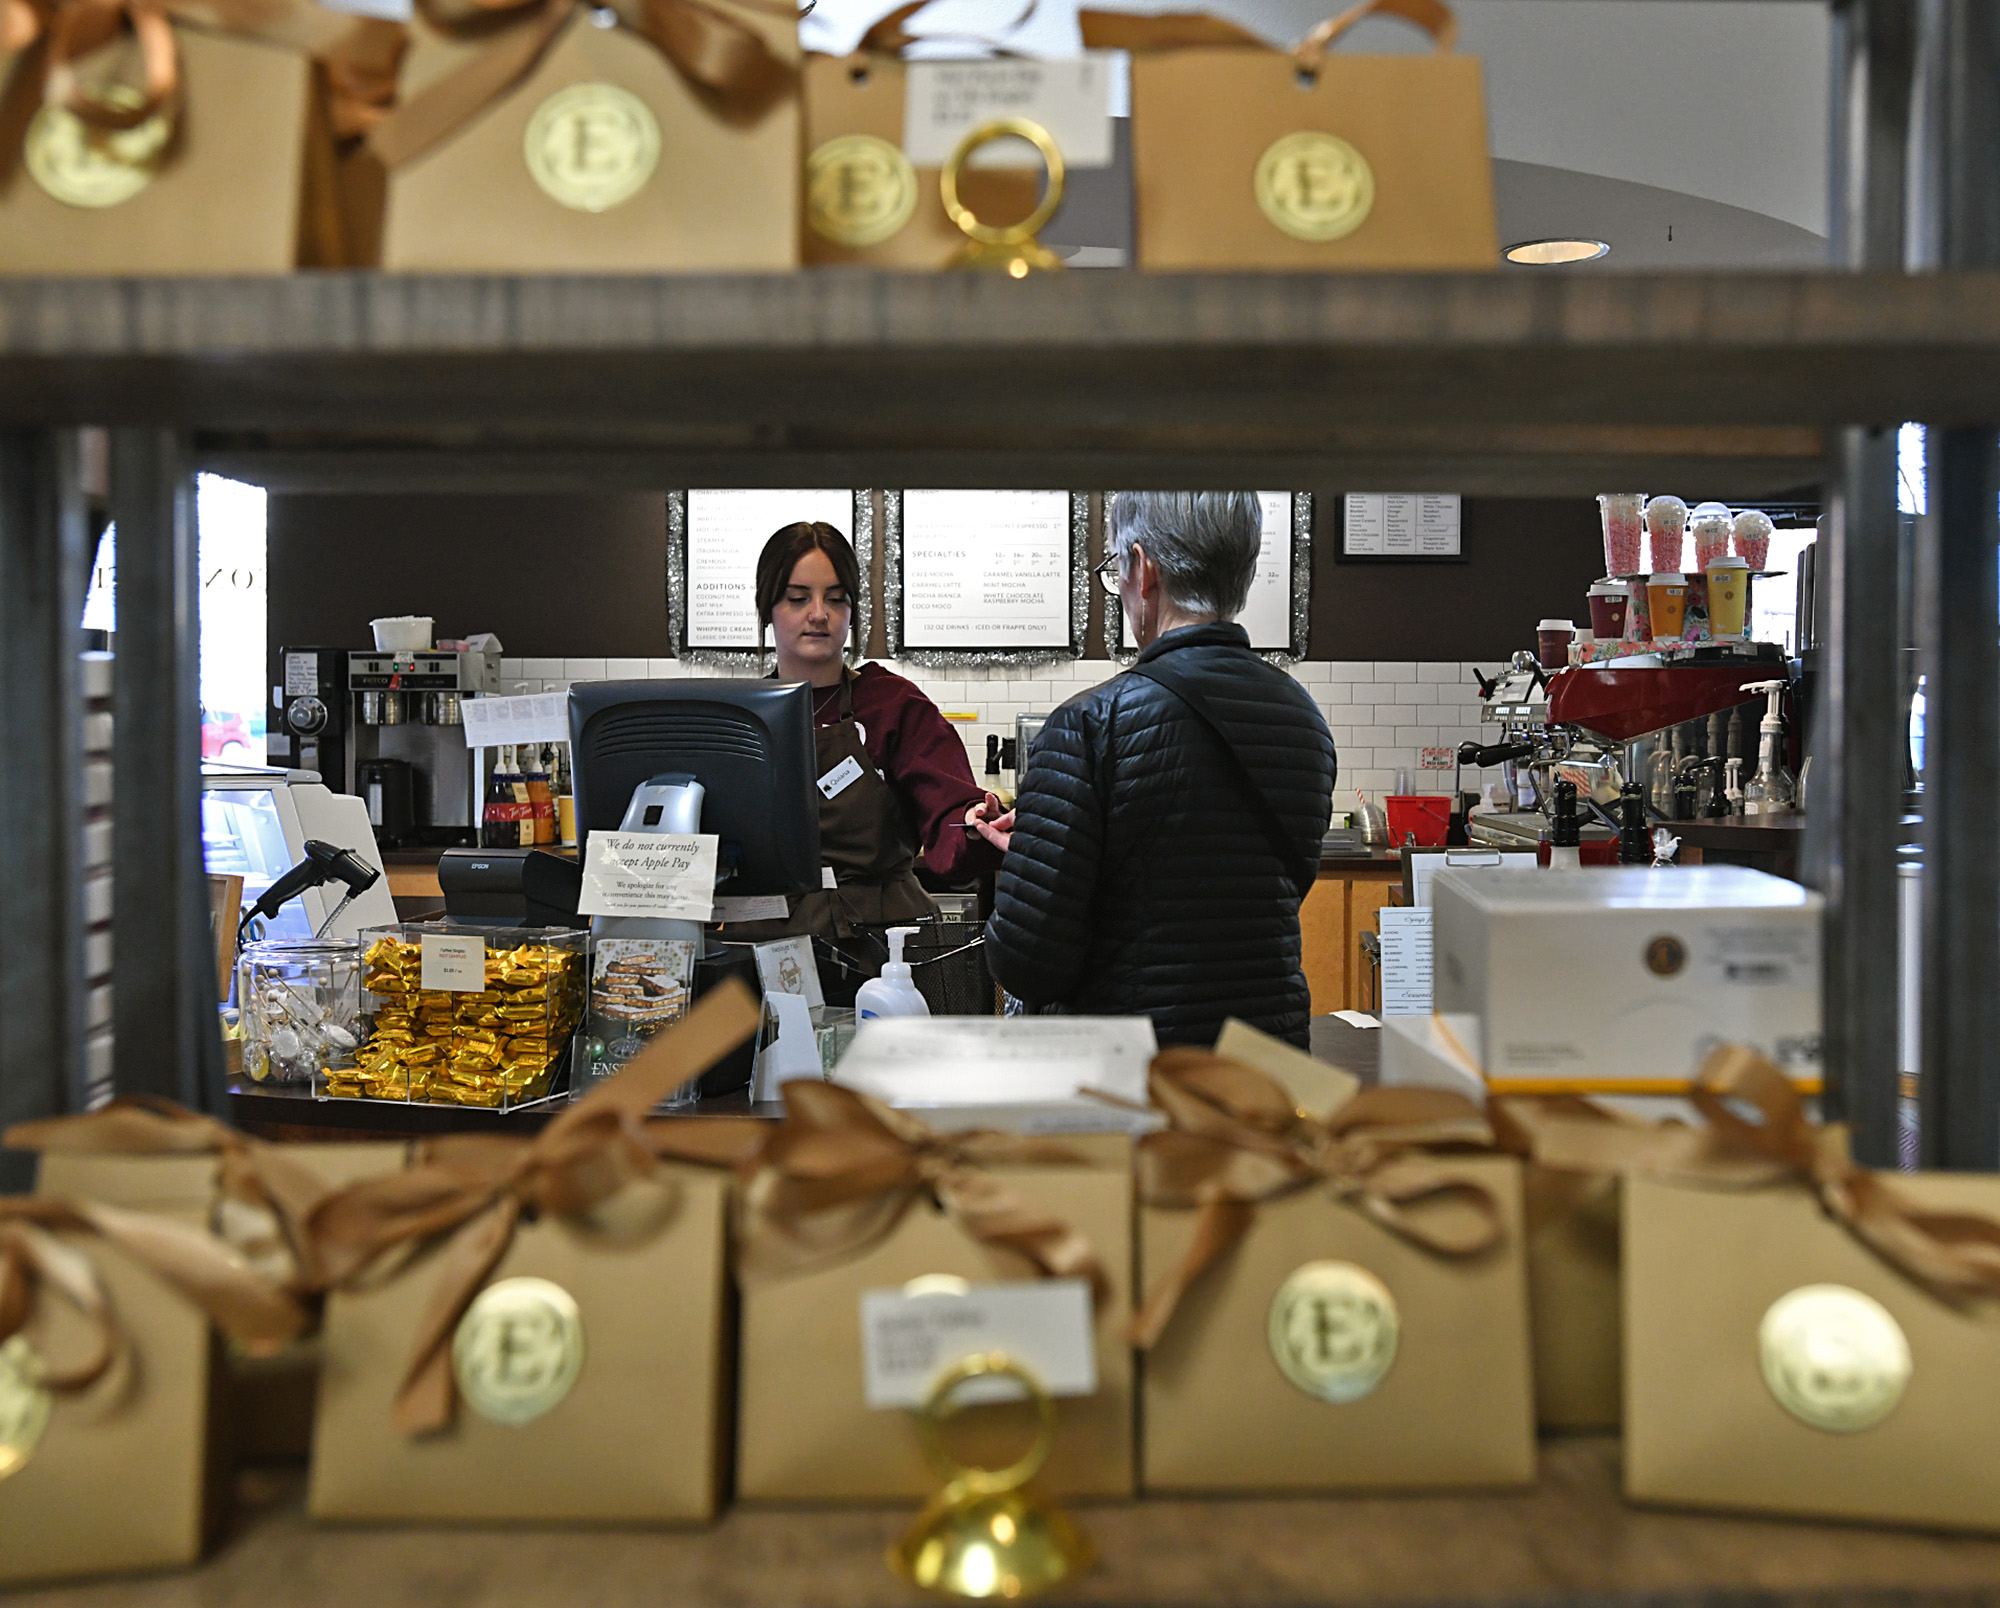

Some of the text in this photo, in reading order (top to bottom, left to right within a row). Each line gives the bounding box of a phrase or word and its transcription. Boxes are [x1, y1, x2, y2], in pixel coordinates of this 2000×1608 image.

[912, 550, 967, 558] SPECIALTIES
[696, 583, 747, 591] ADDITIONS
[829, 770, 851, 786] Quiana
[606, 838, 700, 855] We do not currently
[640, 857, 670, 871] Apple
[671, 858, 691, 872] Pay
[626, 881, 654, 891] apologize
[655, 881, 665, 889] for
[644, 891, 656, 899] this
[591, 1058, 631, 1077] ENST
